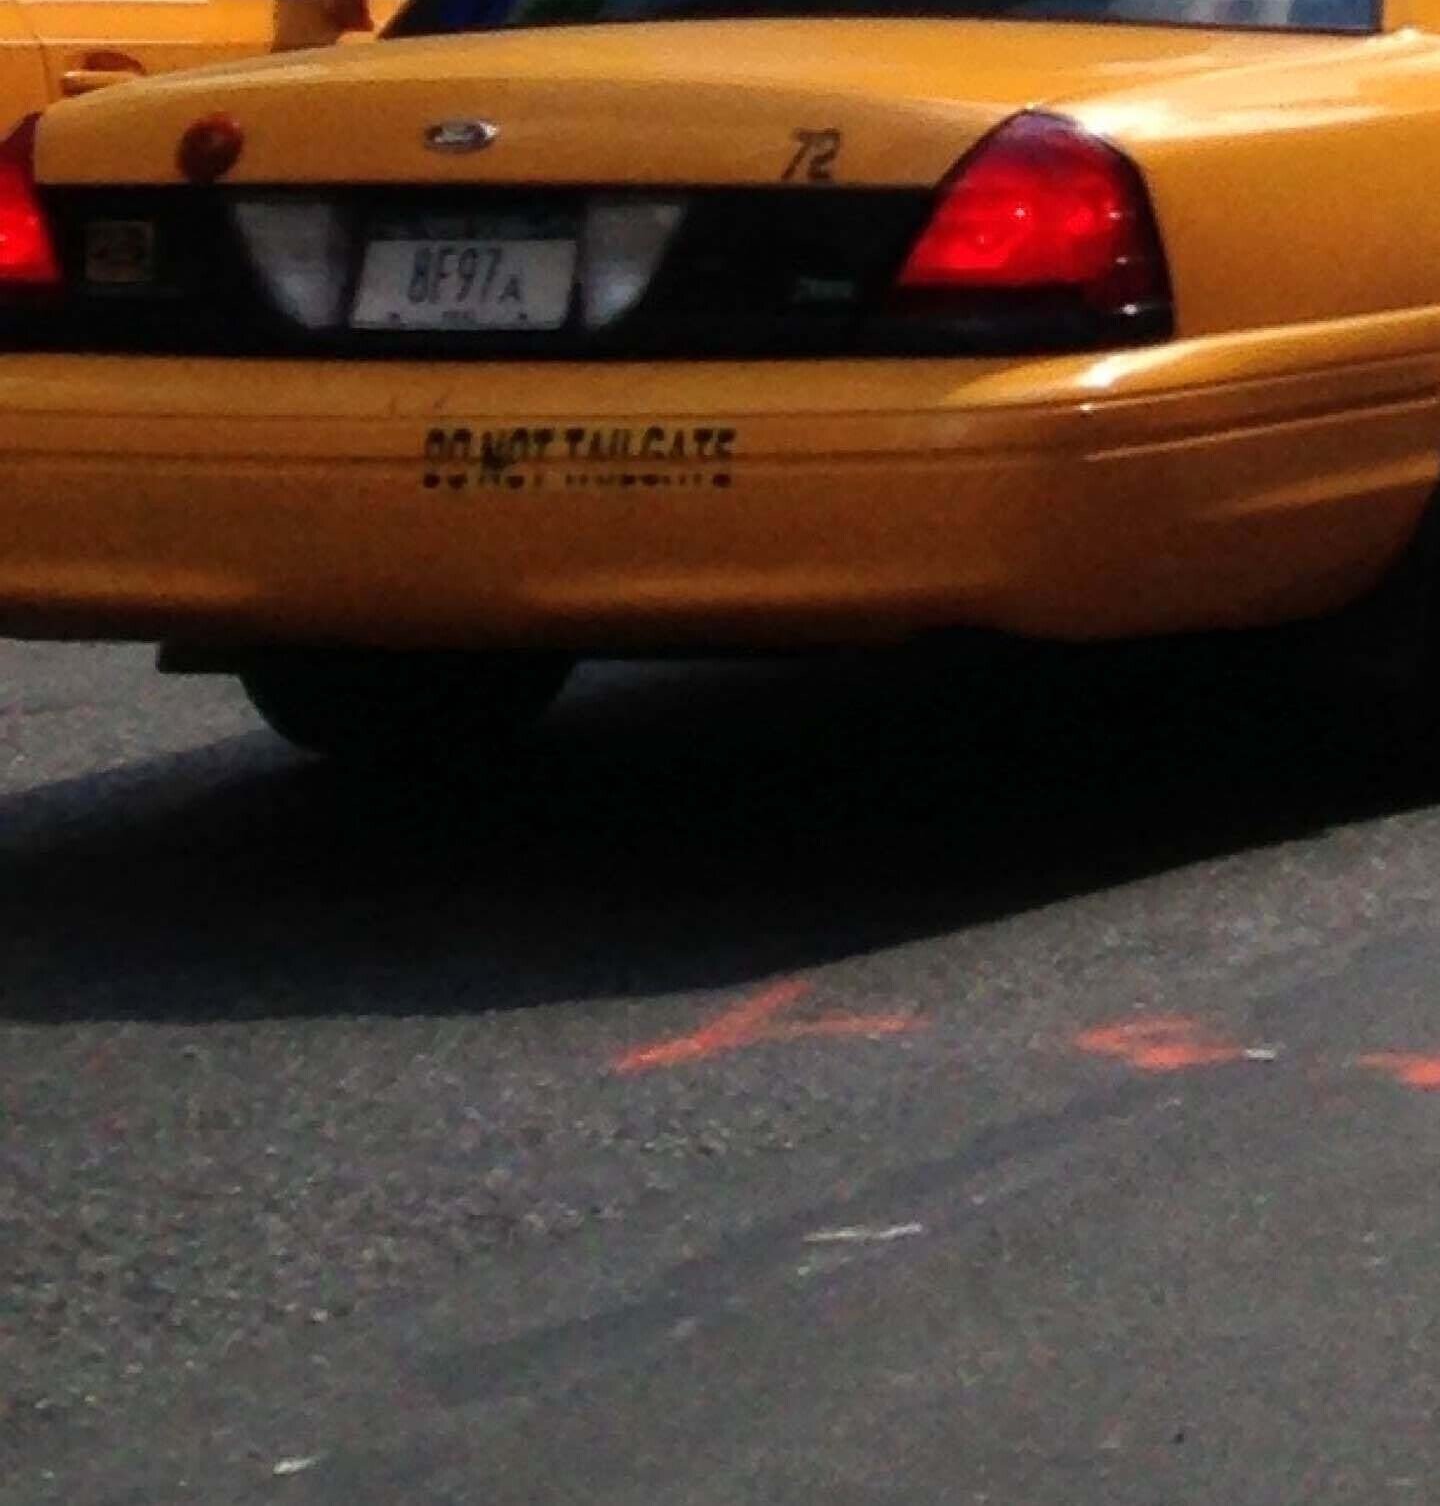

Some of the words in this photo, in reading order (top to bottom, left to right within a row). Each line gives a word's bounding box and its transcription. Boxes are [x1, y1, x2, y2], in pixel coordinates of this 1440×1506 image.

[423, 426, 472, 489] DO
[481, 426, 554, 489] NOT
[564, 426, 736, 489] TAILGATE
